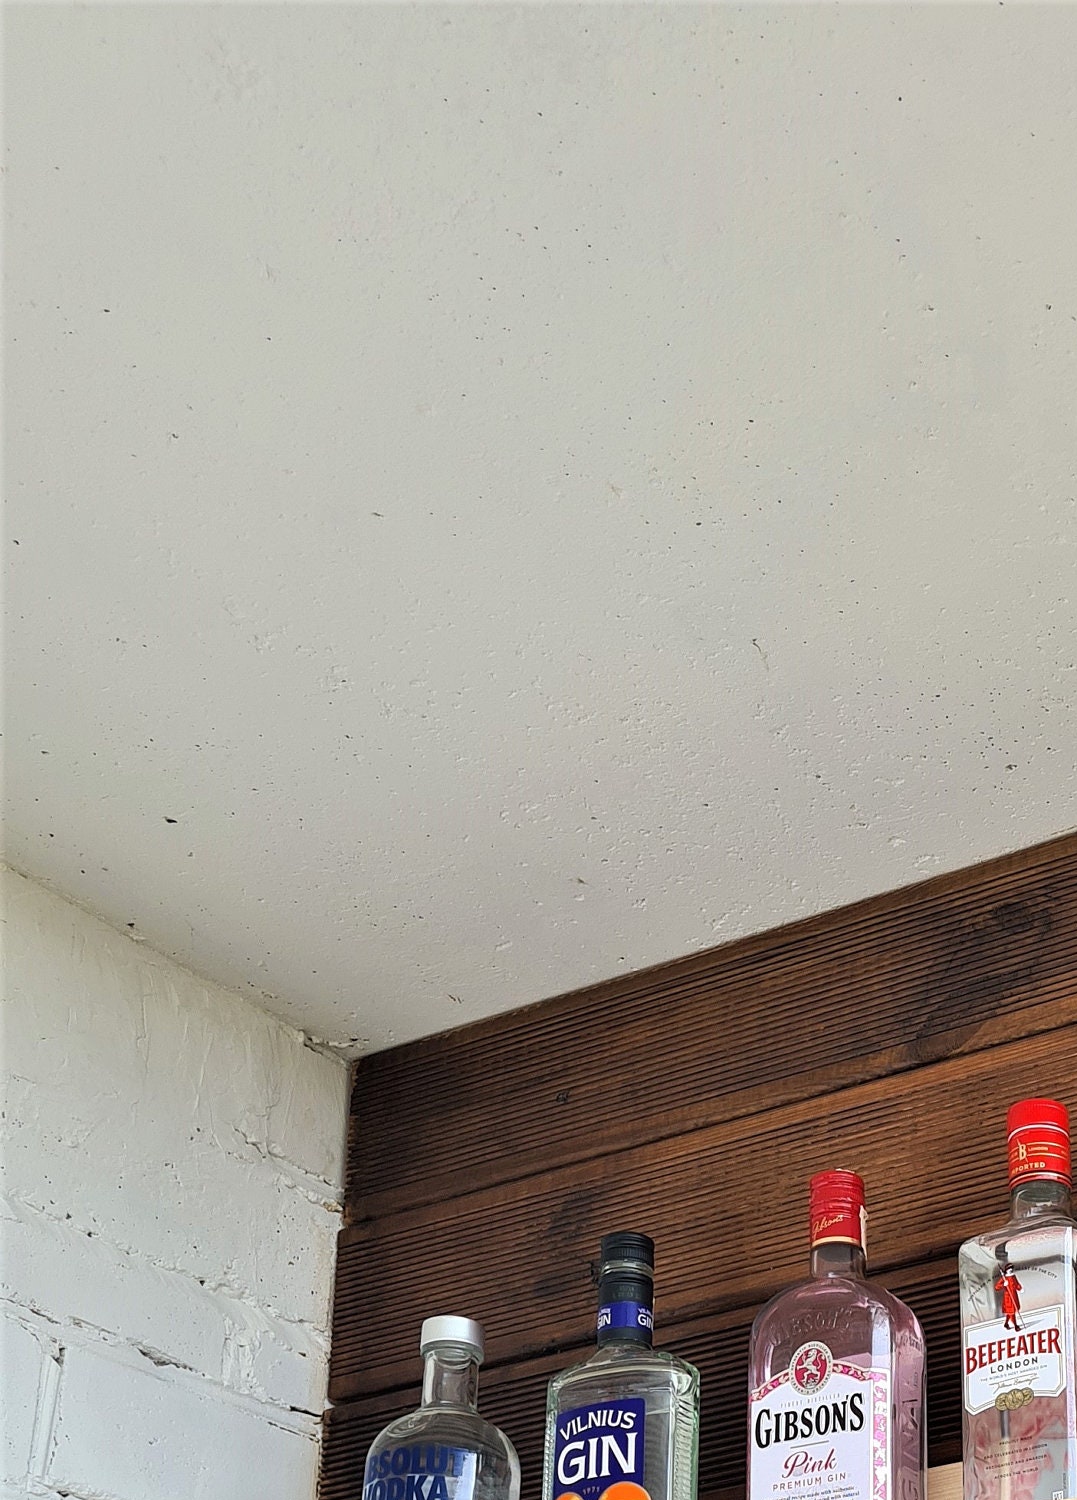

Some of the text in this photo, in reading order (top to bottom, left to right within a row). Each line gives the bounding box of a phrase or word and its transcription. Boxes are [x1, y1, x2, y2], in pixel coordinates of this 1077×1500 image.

[1011, 1161, 1046, 1175] MPORTED
[965, 1327, 1062, 1376] BEEFEATER
[990, 1356, 1038, 1374] LONDON
[559, 1409, 637, 1442] VILNIUS
[754, 1392, 865, 1449] GIBSON'S
[364, 1445, 465, 1486] BSOLUT
[557, 1431, 638, 1486] GIN
[782, 1448, 838, 1479] Pink
[772, 1472, 847, 1492] PREMIUM GIN
